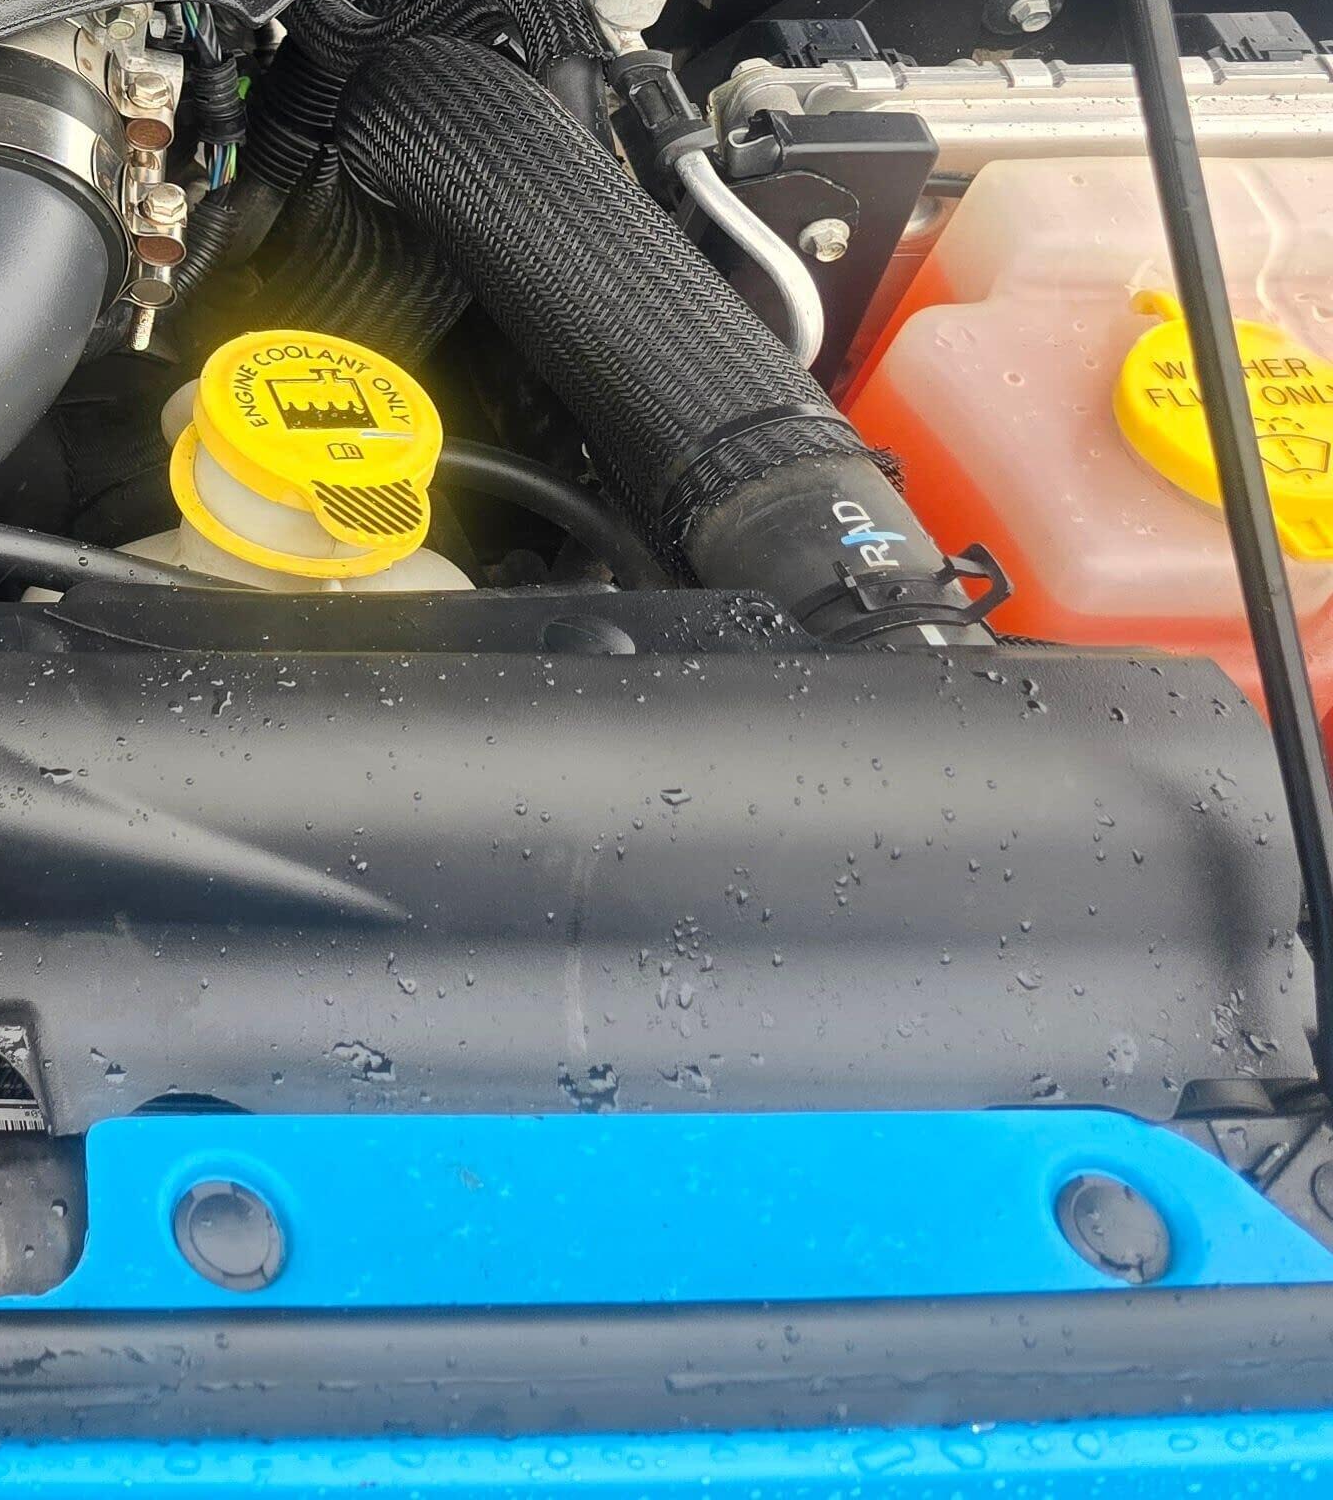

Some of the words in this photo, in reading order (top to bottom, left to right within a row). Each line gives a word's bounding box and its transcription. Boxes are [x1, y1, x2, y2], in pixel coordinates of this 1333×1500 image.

[233, 364, 269, 428] ENGINE
[253, 345, 372, 375] COOLANT
[373, 377, 411, 425] ONLY
[1153, 357, 1314, 381] WHER
[832, 501, 900, 568] RAD
